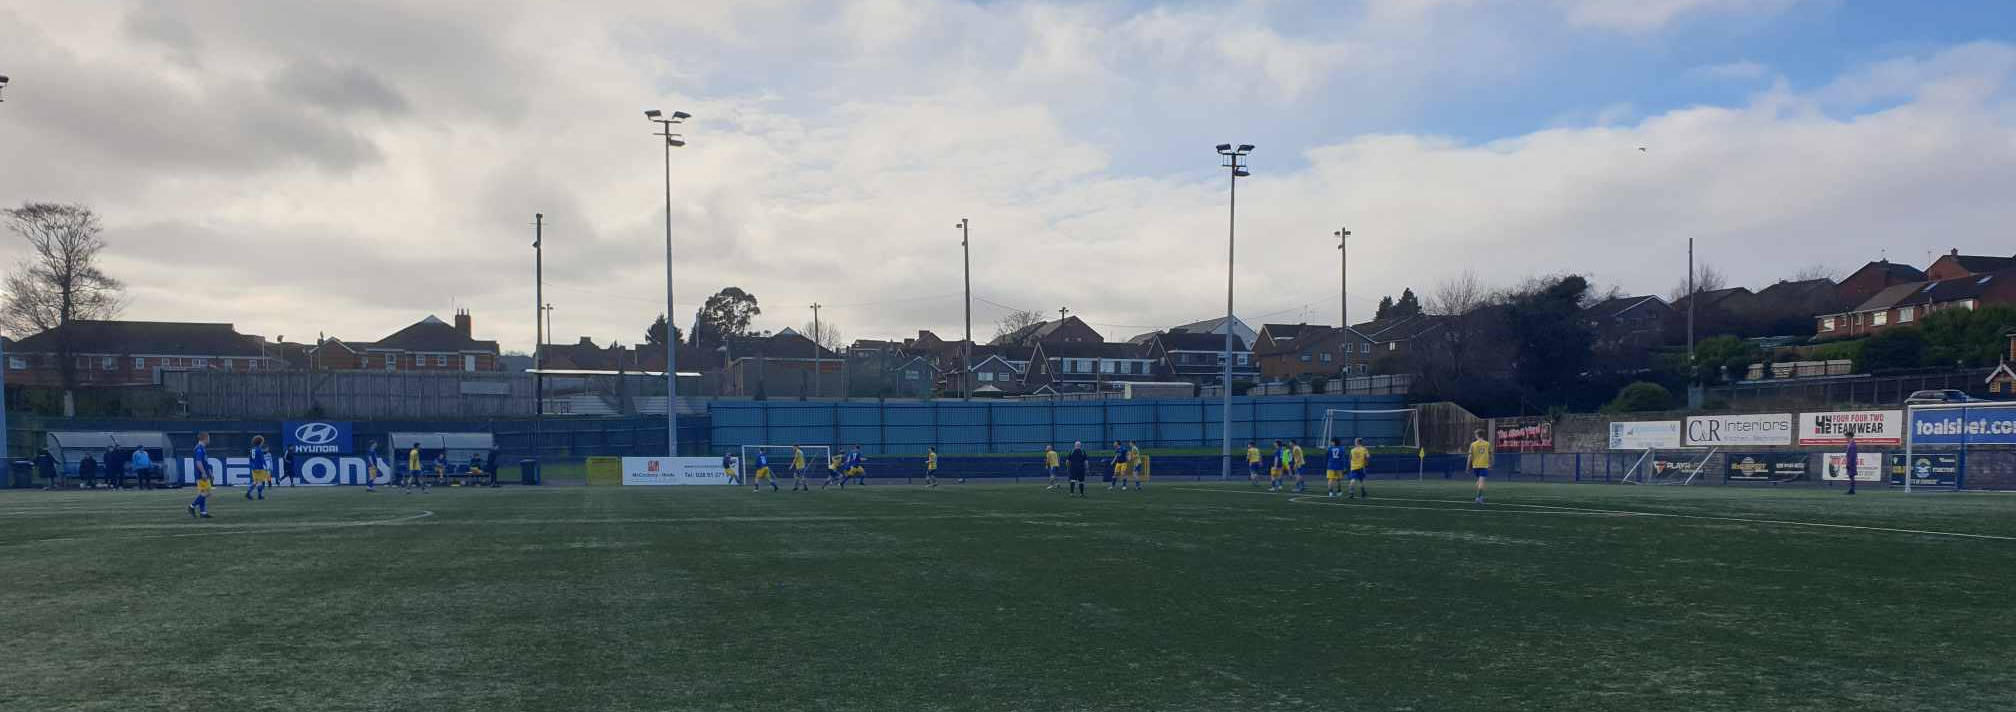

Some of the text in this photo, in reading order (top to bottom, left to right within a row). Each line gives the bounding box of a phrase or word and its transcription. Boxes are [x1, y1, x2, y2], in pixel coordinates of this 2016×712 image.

[1870, 413, 1884, 422] TWO
[1724, 419, 1789, 432] Interiors
[1833, 422, 1884, 434] TEAMWEAR
[1916, 418, 2016, 435] toalsbet.co
[295, 445, 339, 453] HYUNDAI
